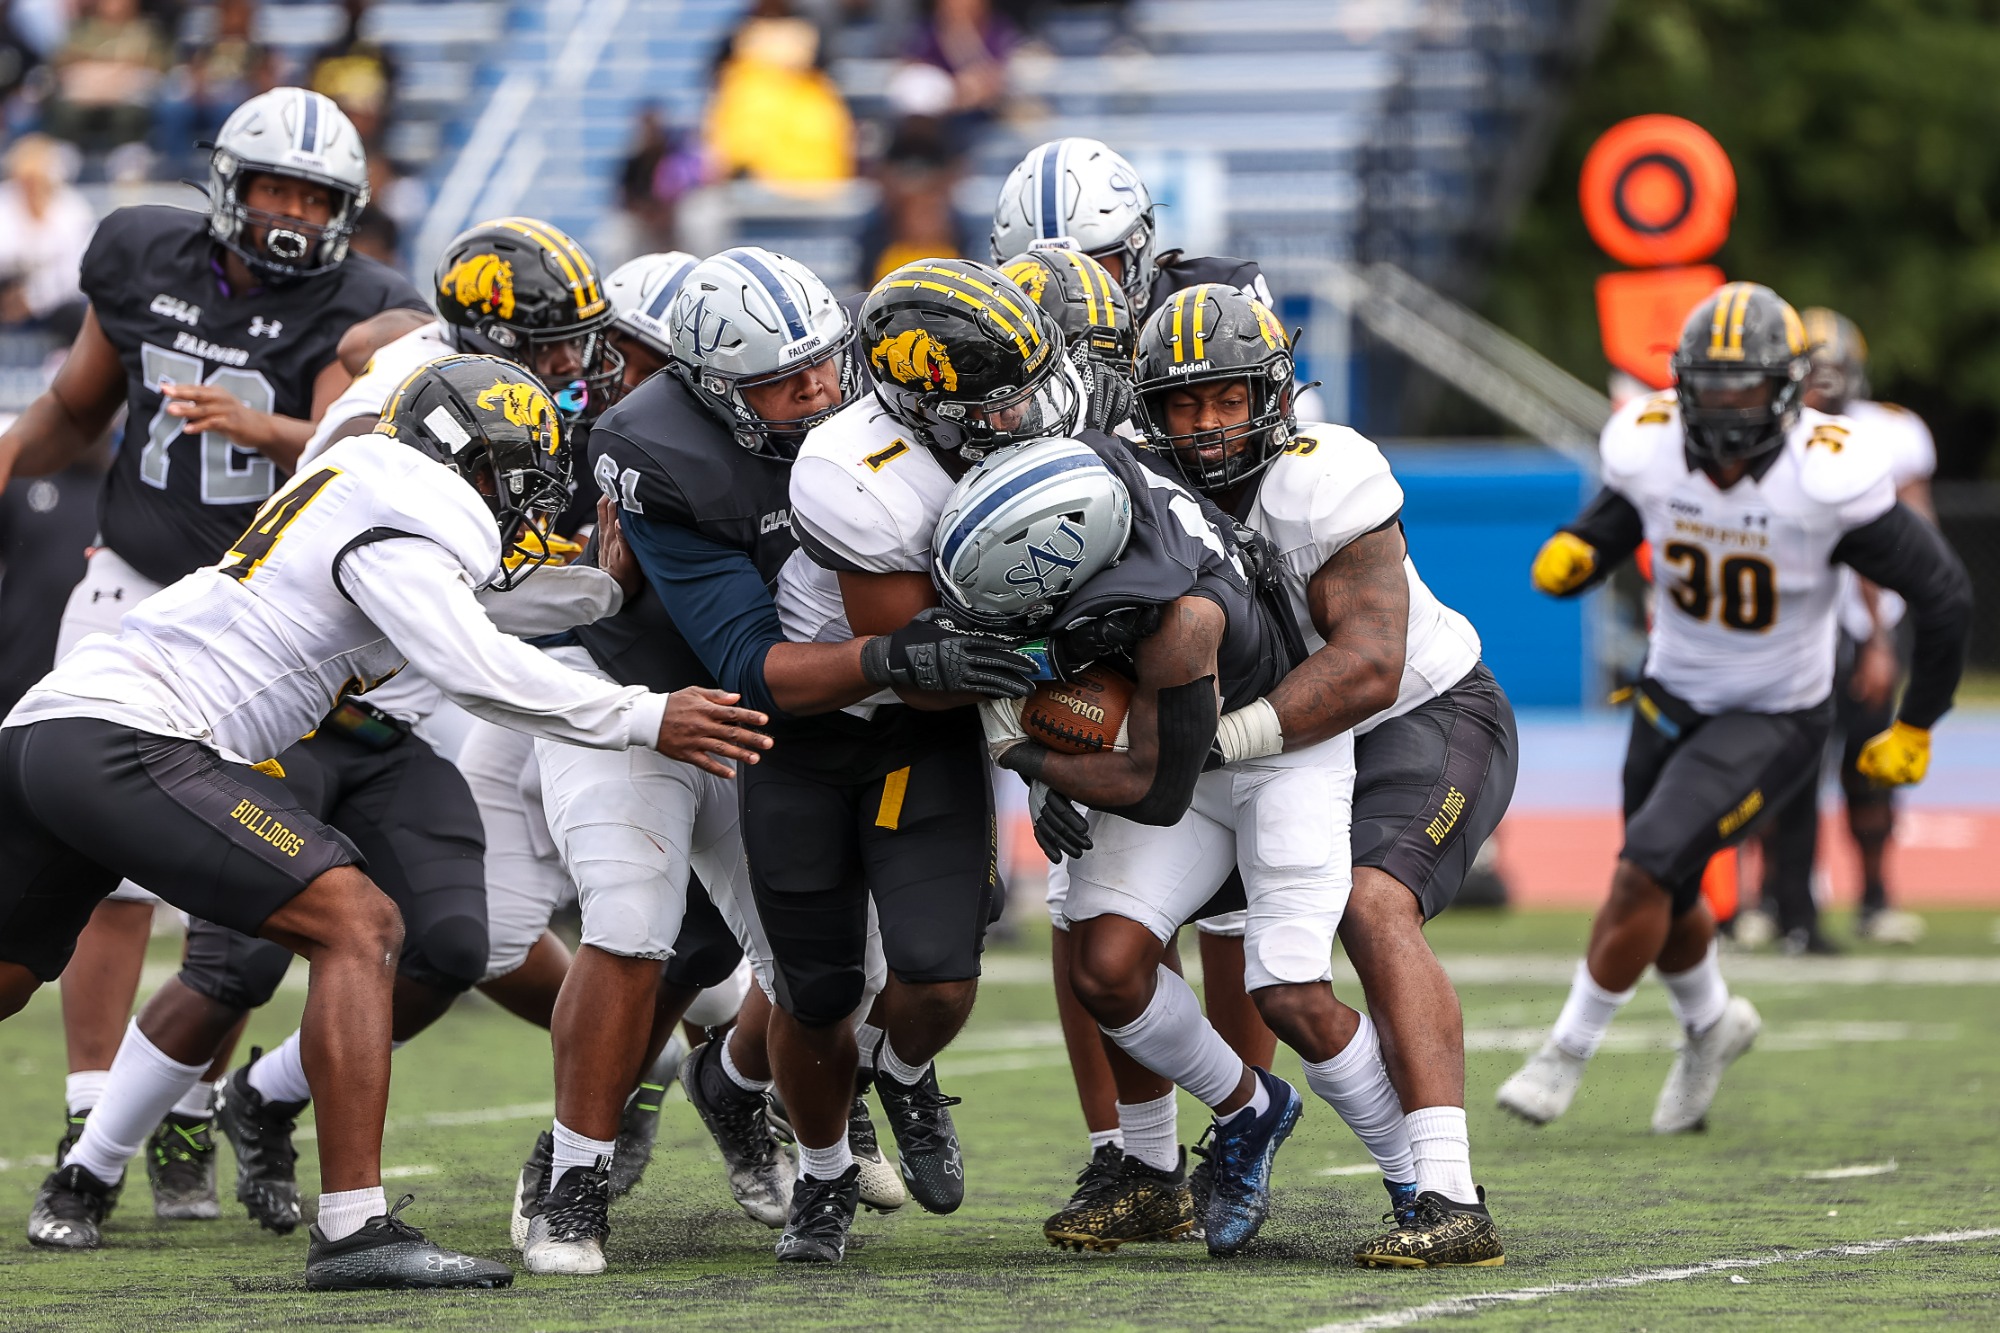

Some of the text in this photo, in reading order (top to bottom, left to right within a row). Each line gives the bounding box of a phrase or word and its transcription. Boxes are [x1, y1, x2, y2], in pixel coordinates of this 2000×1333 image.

[173, 331, 250, 367] FALCONS
[673, 293, 733, 361] SAU
[788, 336, 821, 359] FALCONS
[840, 353, 852, 391] Riddell
[1169, 360, 1211, 376] Riddell
[140, 341, 276, 505] 72
[594, 453, 644, 515] 61
[862, 437, 910, 473] 1
[220, 466, 344, 584] 4
[760, 509, 791, 535] CIA
[1004, 514, 1086, 601] SAU
[1664, 541, 1777, 635] 30
[1048, 690, 1105, 724] Wilson
[230, 798, 305, 857] BULLDOGS
[1425, 786, 1466, 846] BULLDOGS
